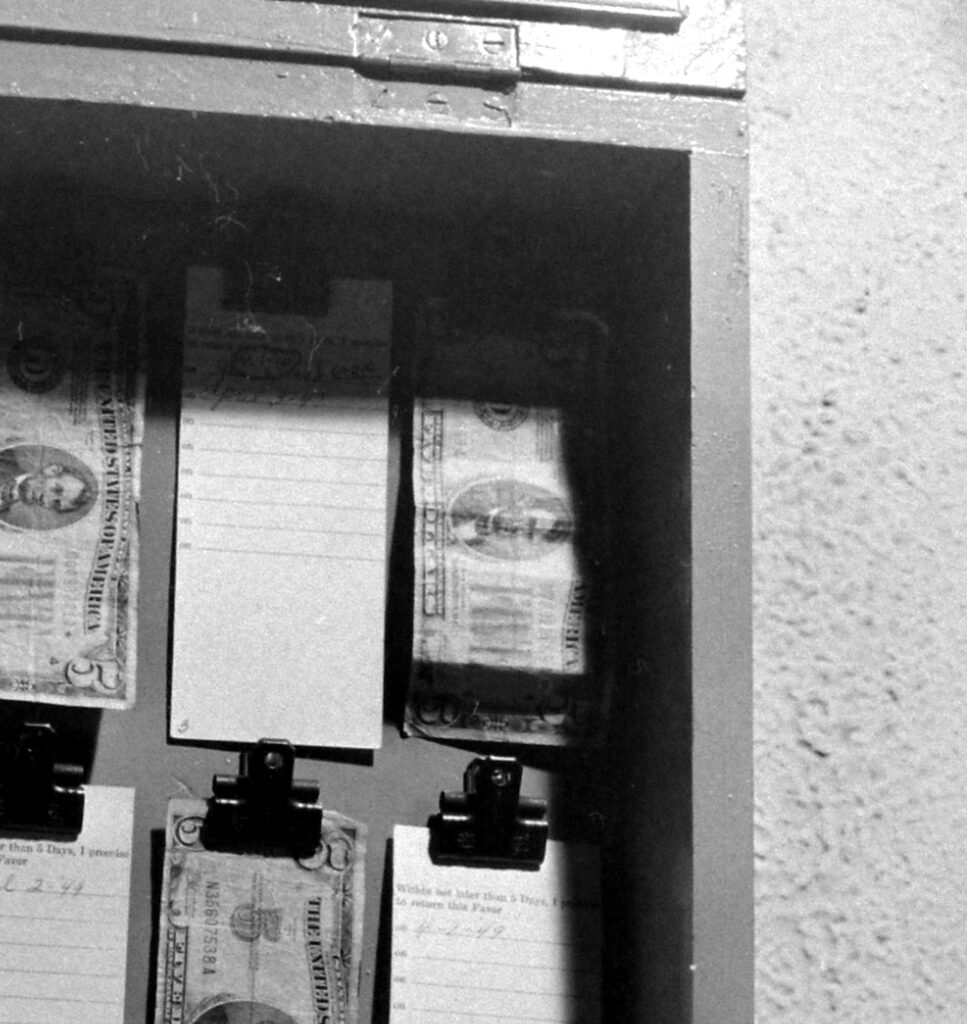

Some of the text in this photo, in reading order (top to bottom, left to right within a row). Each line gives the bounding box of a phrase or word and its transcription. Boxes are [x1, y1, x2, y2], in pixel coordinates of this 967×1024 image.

[64, 657, 123, 694] 5
[9, 843, 34, 854] than
[88, 849, 131, 860] promise
[306, 897, 322, 937] THE
[396, 897, 503, 915] to return this Favor
[306, 940, 331, 1013] UNITED
